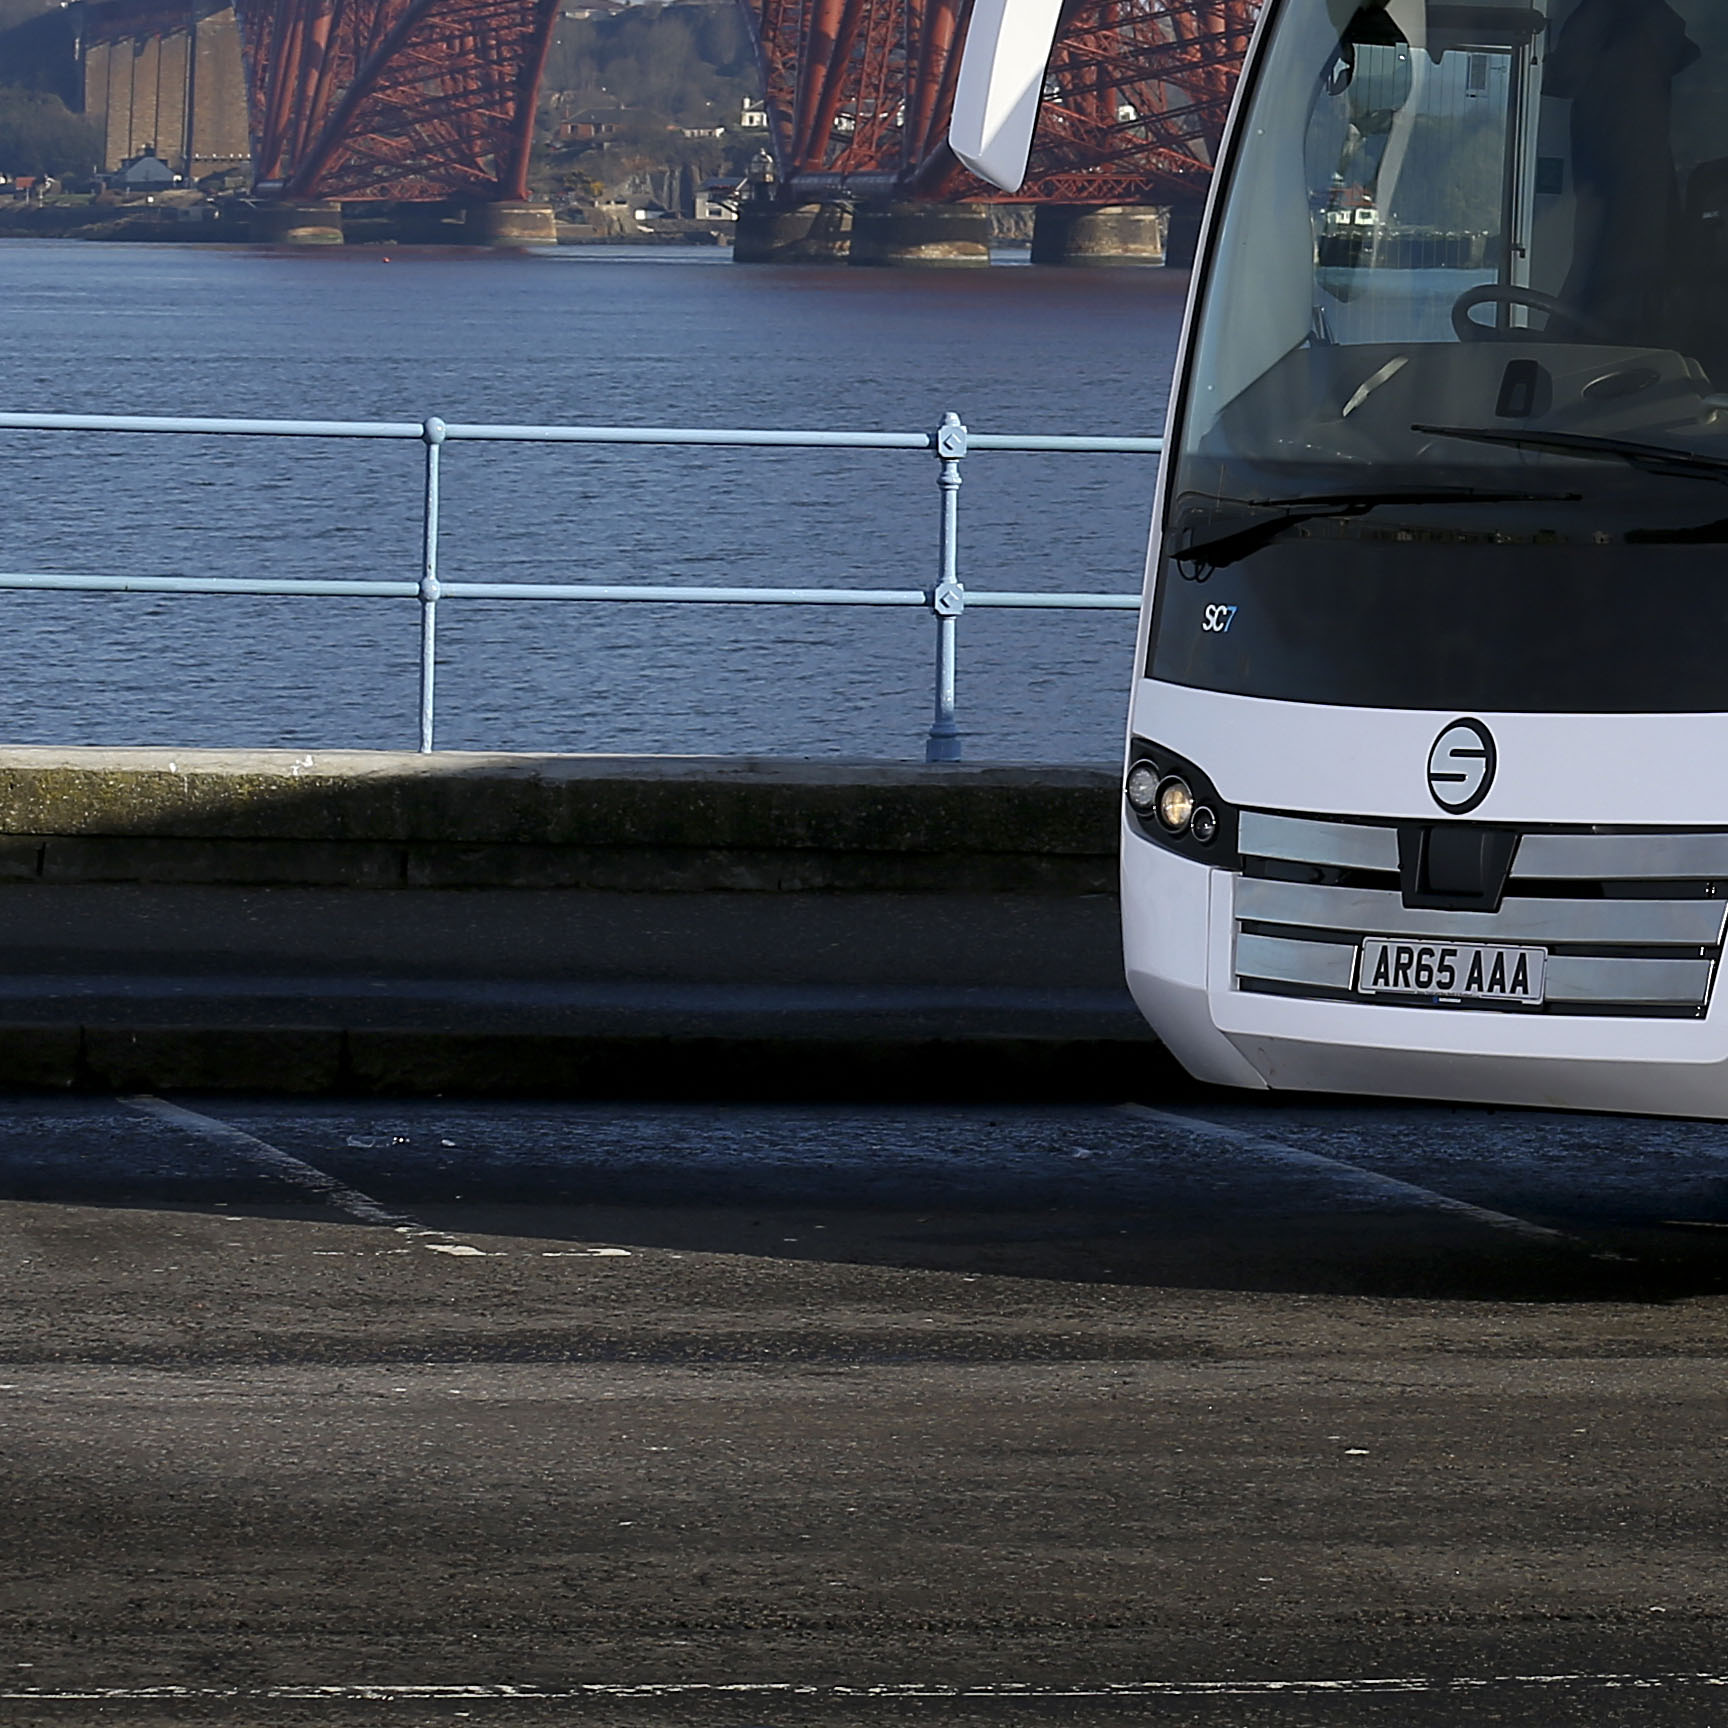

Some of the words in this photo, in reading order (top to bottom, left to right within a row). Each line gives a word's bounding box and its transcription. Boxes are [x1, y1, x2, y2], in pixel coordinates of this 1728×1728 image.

[1202, 604, 1238, 632] SC7
[1372, 945, 1458, 990] AR65
[1465, 950, 1530, 995] AAA
